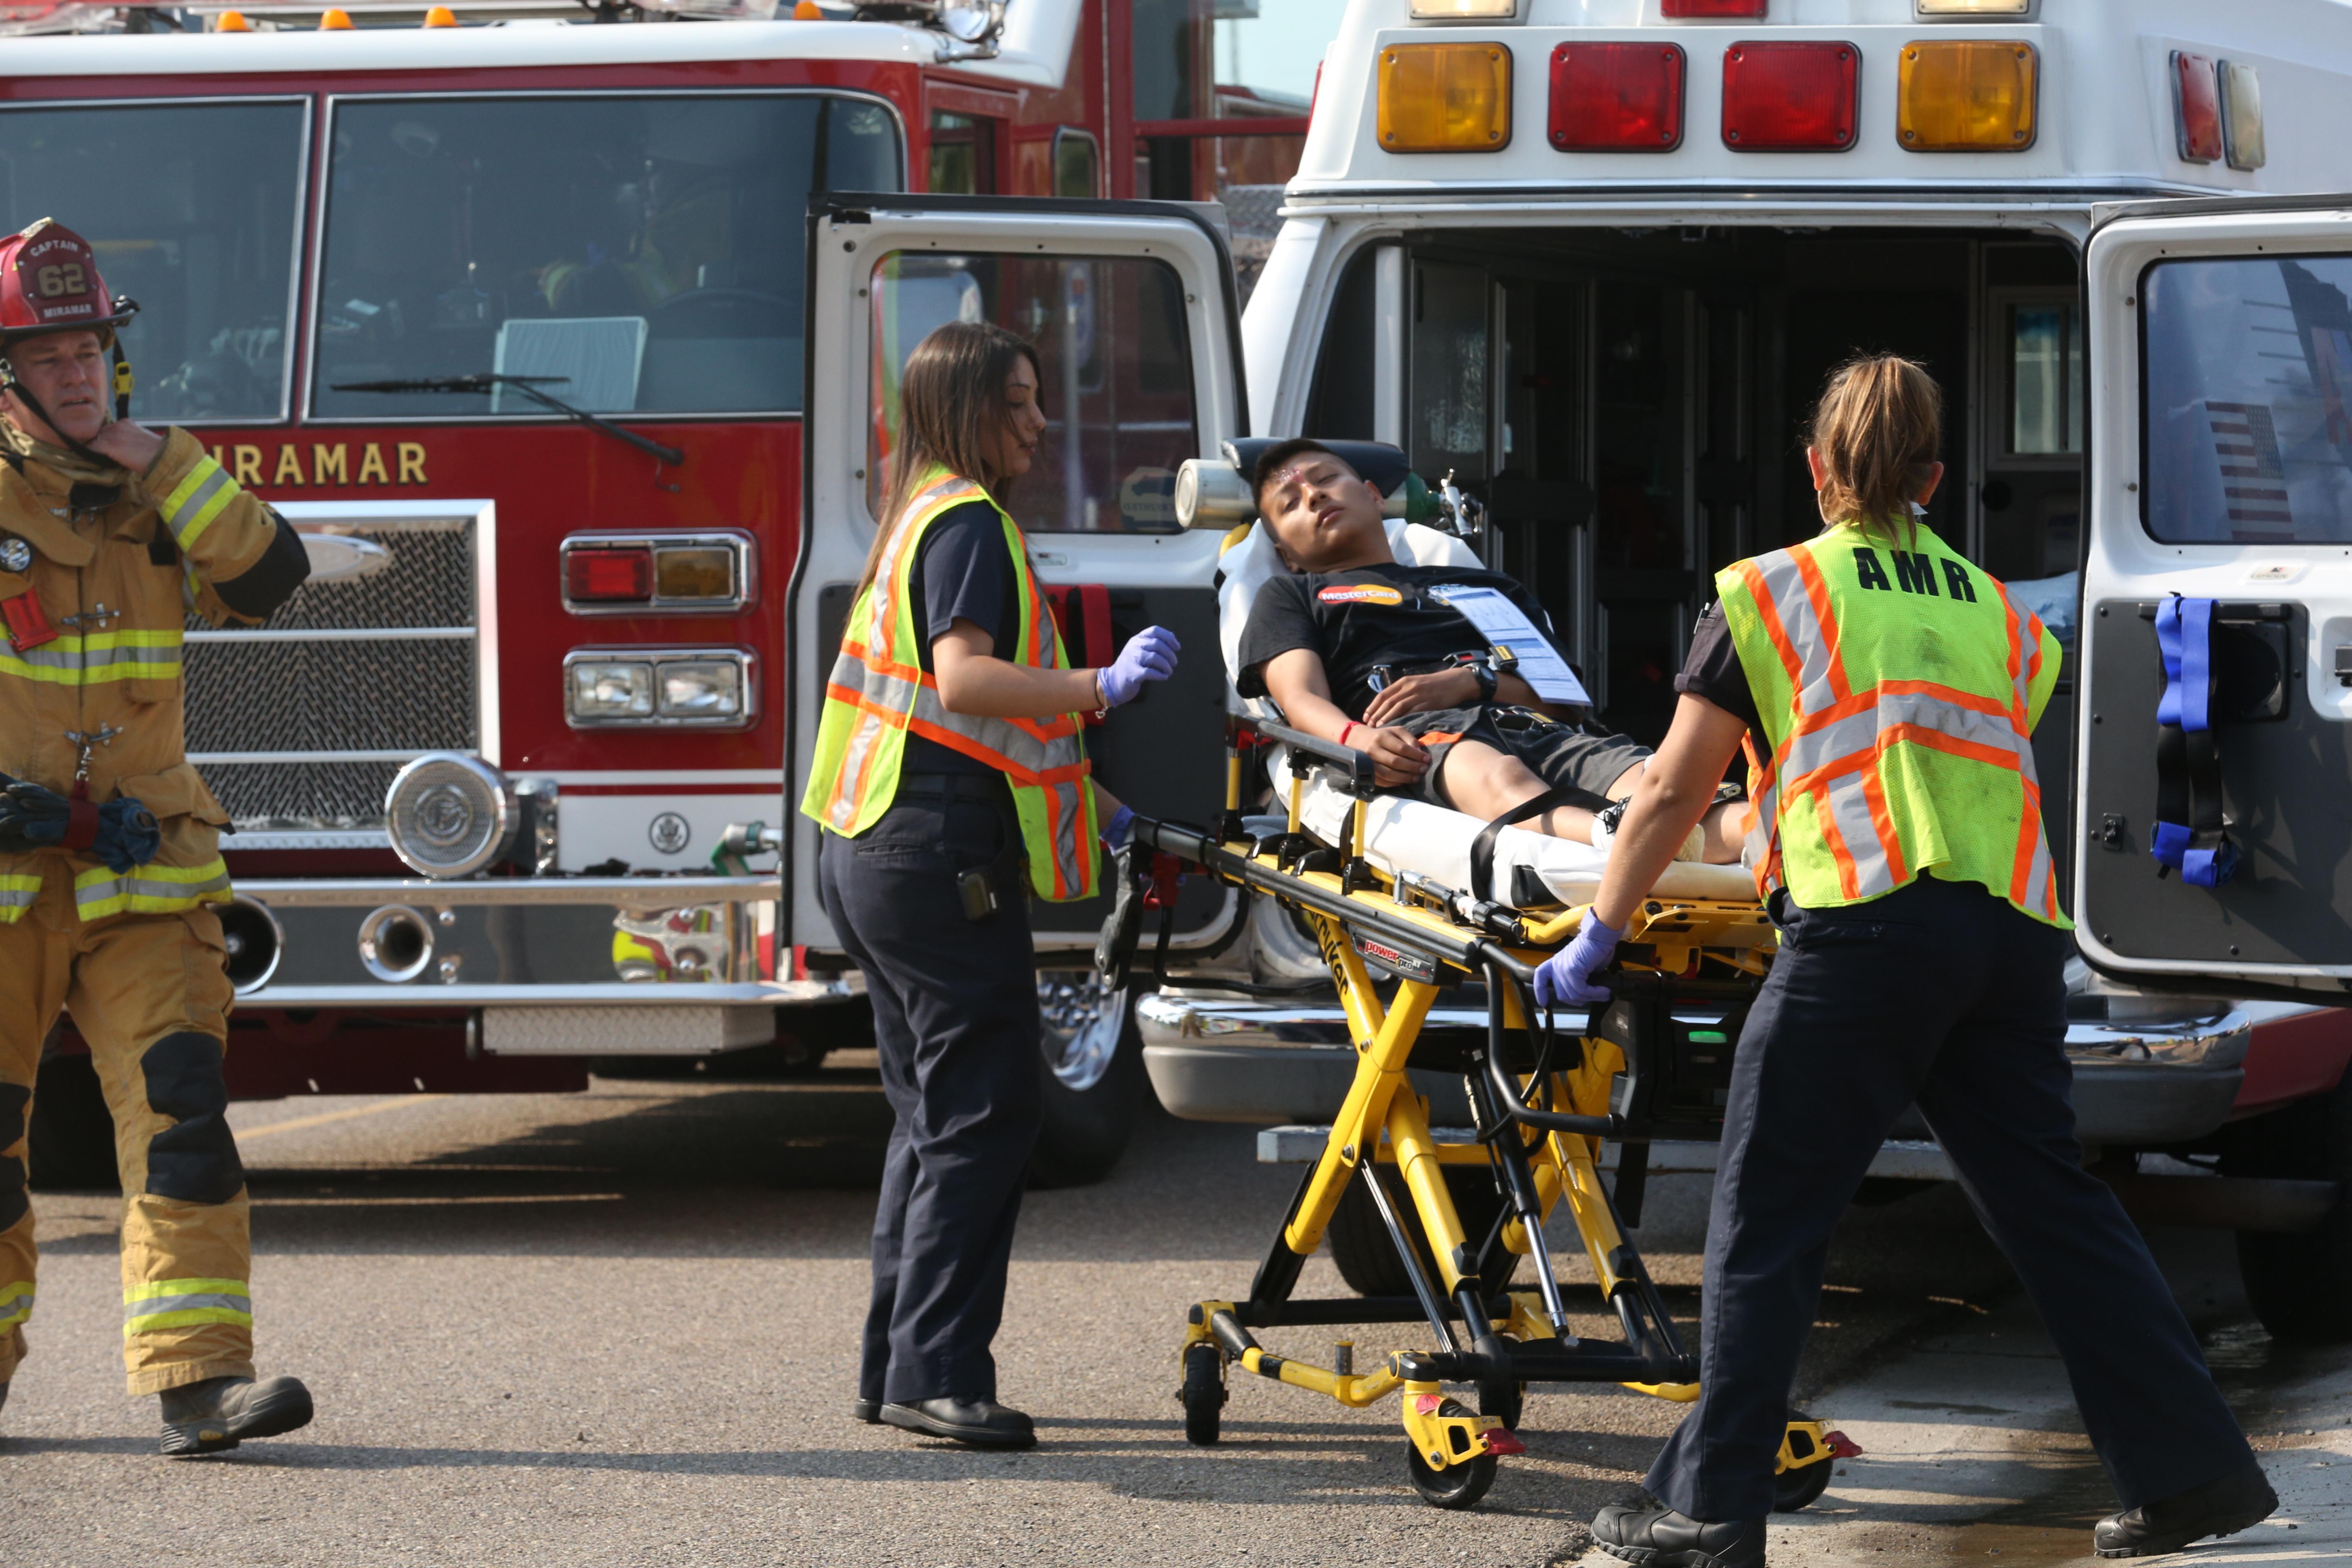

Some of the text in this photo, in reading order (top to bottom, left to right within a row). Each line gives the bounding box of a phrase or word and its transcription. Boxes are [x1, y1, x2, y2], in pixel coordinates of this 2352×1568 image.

[30, 239, 78, 257] CAPTAIN
[38, 263, 86, 297] 62
[43, 304, 92, 318] MIRAMAR
[1853, 547, 1978, 603] AMR
[1321, 590, 1399, 601] MasterCard
[1365, 940, 1399, 962] power
